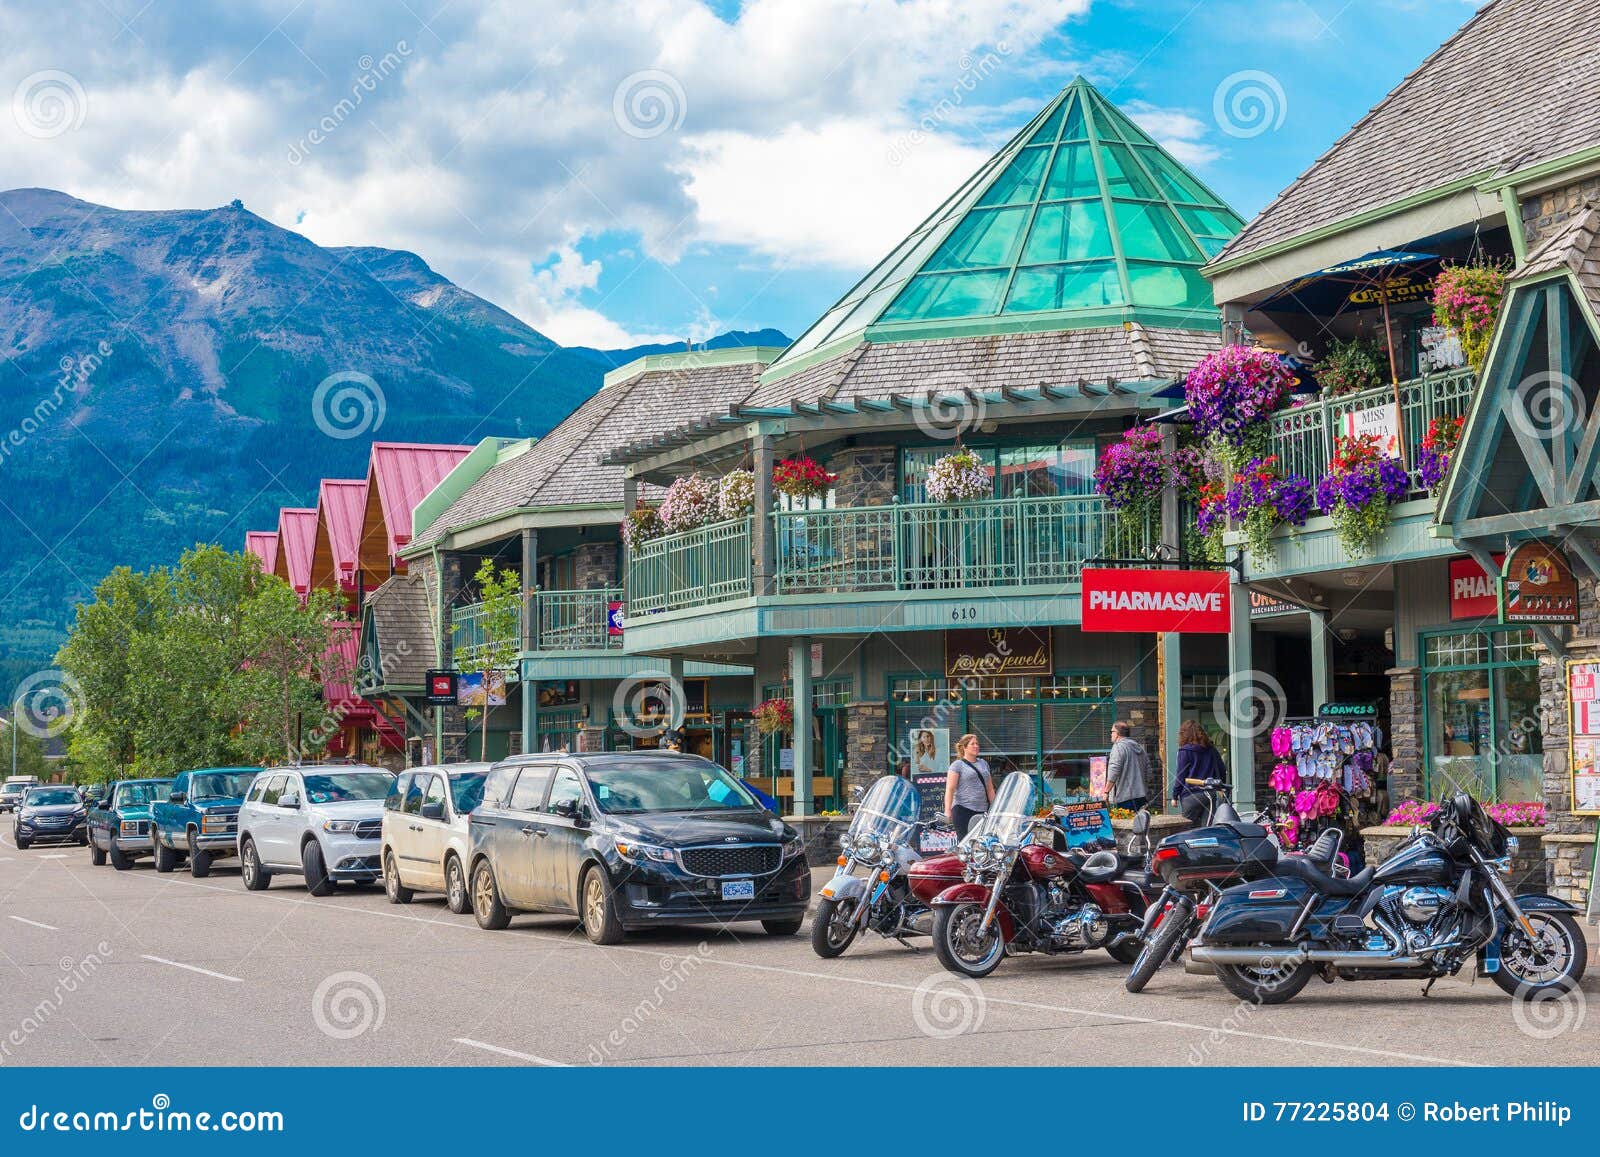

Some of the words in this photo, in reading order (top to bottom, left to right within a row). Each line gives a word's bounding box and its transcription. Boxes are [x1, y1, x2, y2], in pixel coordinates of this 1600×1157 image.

[1361, 408, 1385, 425] MISS
[1089, 590, 1222, 612] PHARMASAVE
[951, 607, 977, 620] 610
[996, 645, 1049, 674] jewels
[1330, 705, 1367, 715] DAWGS
